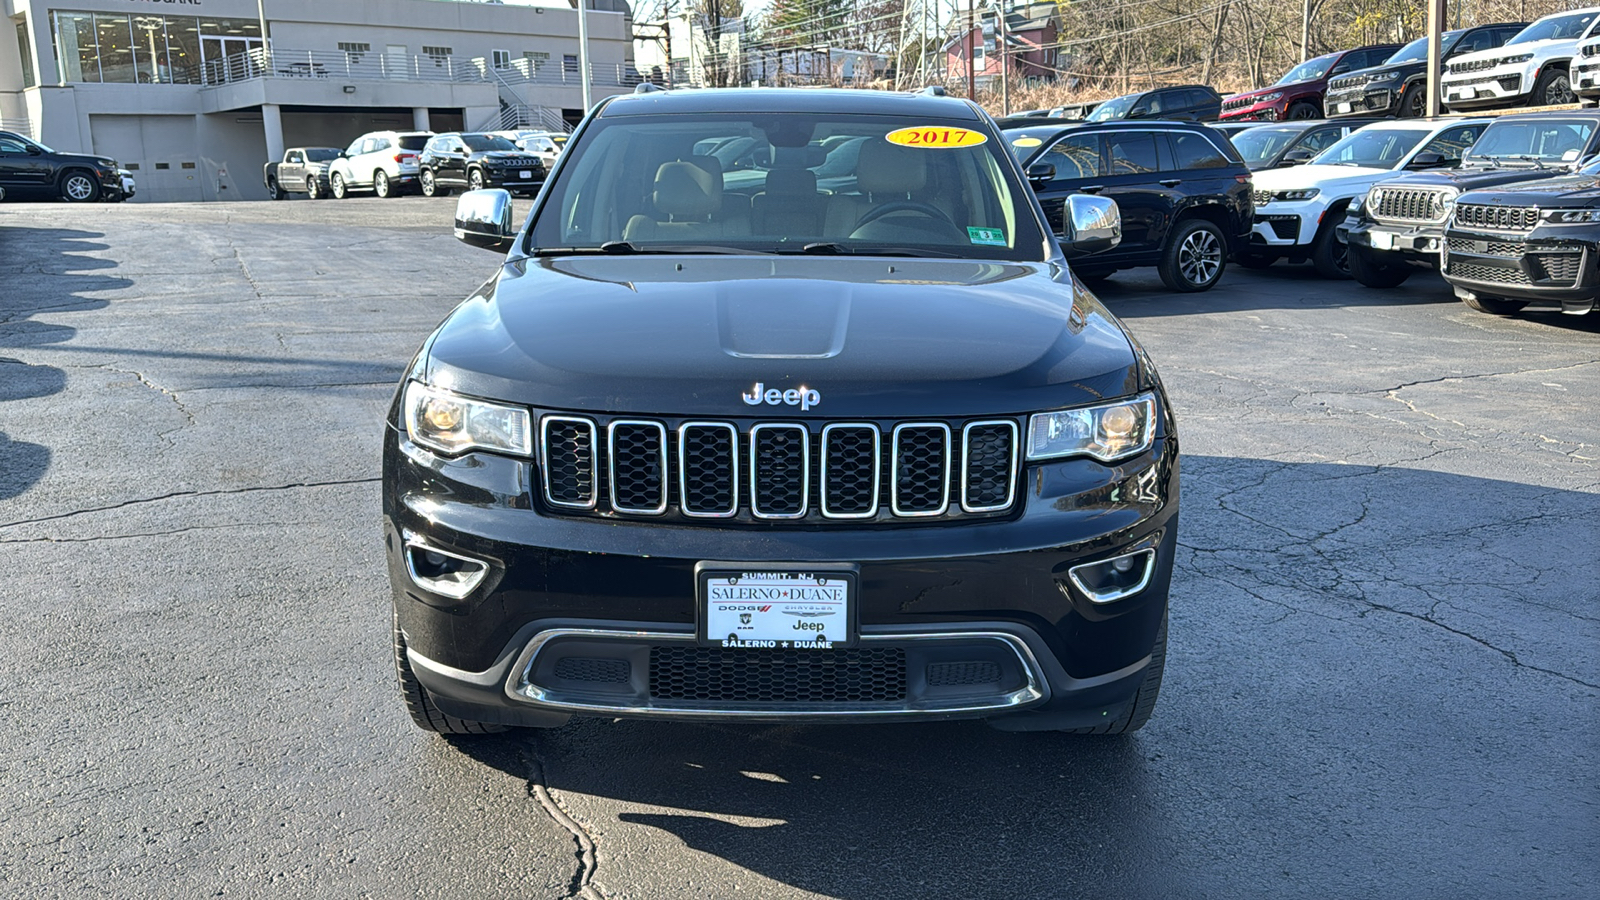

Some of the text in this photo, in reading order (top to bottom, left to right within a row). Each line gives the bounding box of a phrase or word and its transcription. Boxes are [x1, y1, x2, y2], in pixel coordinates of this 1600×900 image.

[907, 131, 968, 144] 2017
[742, 382, 821, 411] Jeep
[712, 587, 843, 601] SALERNO DUANE
[792, 619, 825, 632] Jeep
[722, 640, 833, 649] SALERNO DUANE
